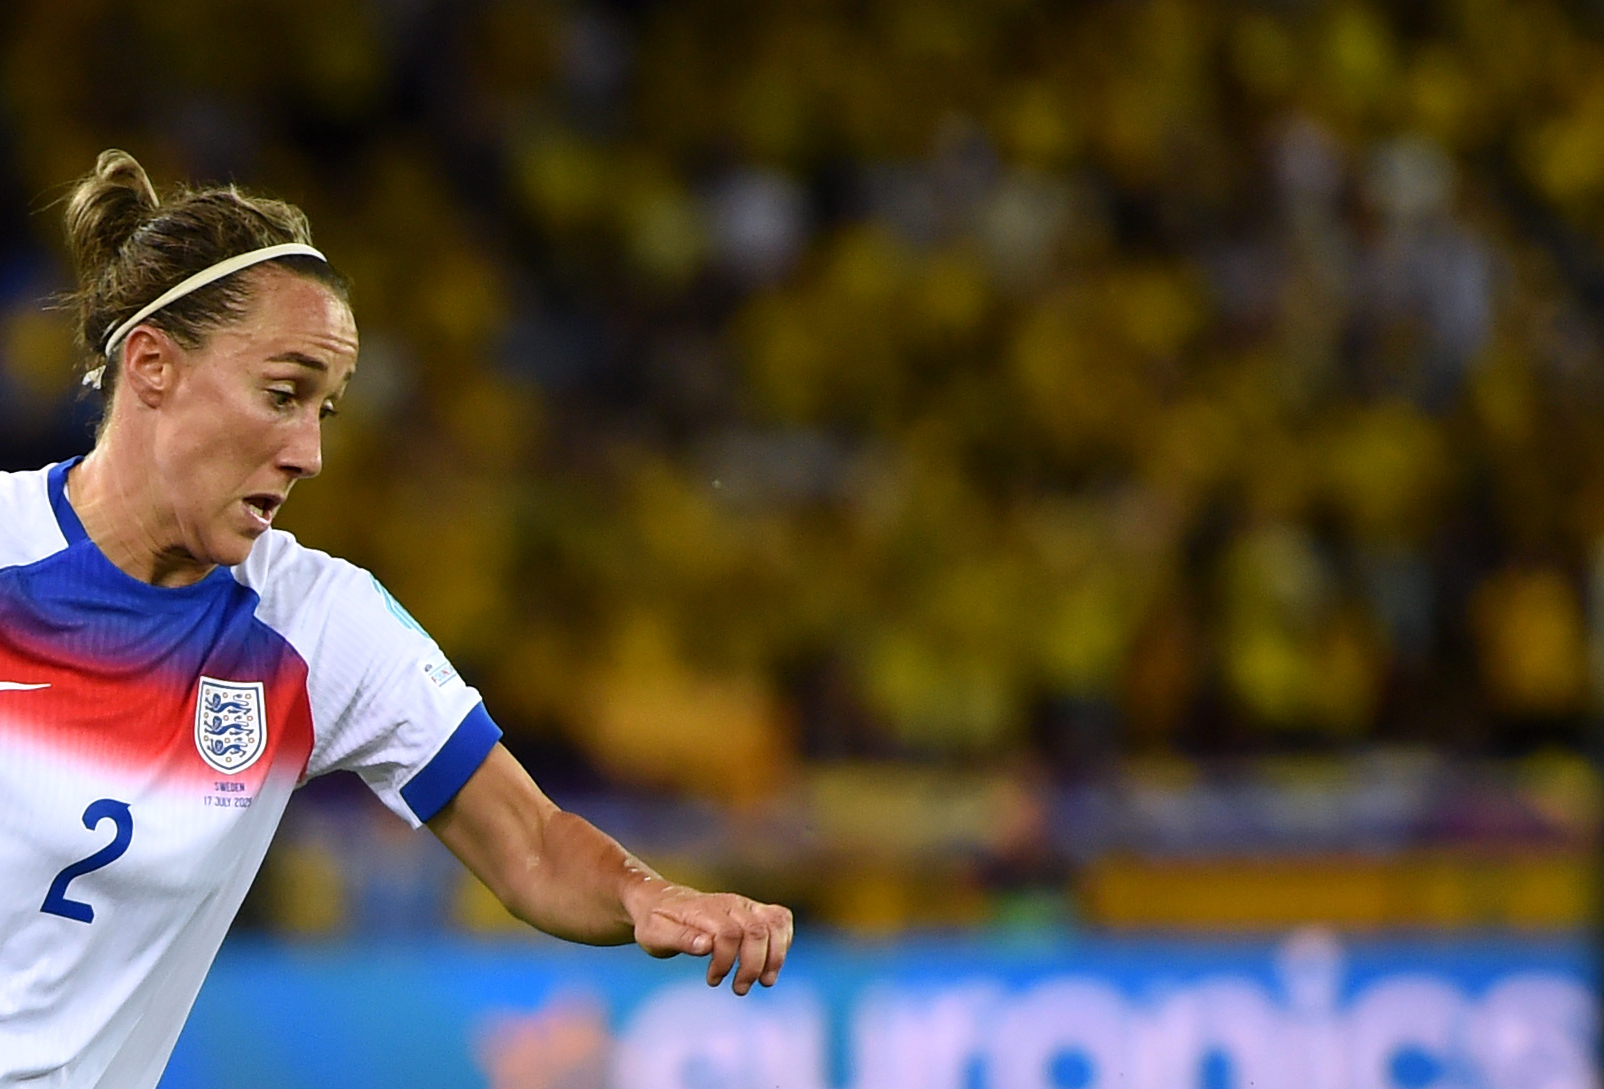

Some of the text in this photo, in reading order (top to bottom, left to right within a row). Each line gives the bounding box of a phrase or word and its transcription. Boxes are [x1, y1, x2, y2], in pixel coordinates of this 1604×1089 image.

[214, 782, 246, 792] SWEDEN
[204, 796, 213, 806] 17
[214, 796, 232, 807] JULY
[40, 799, 134, 924] 2
